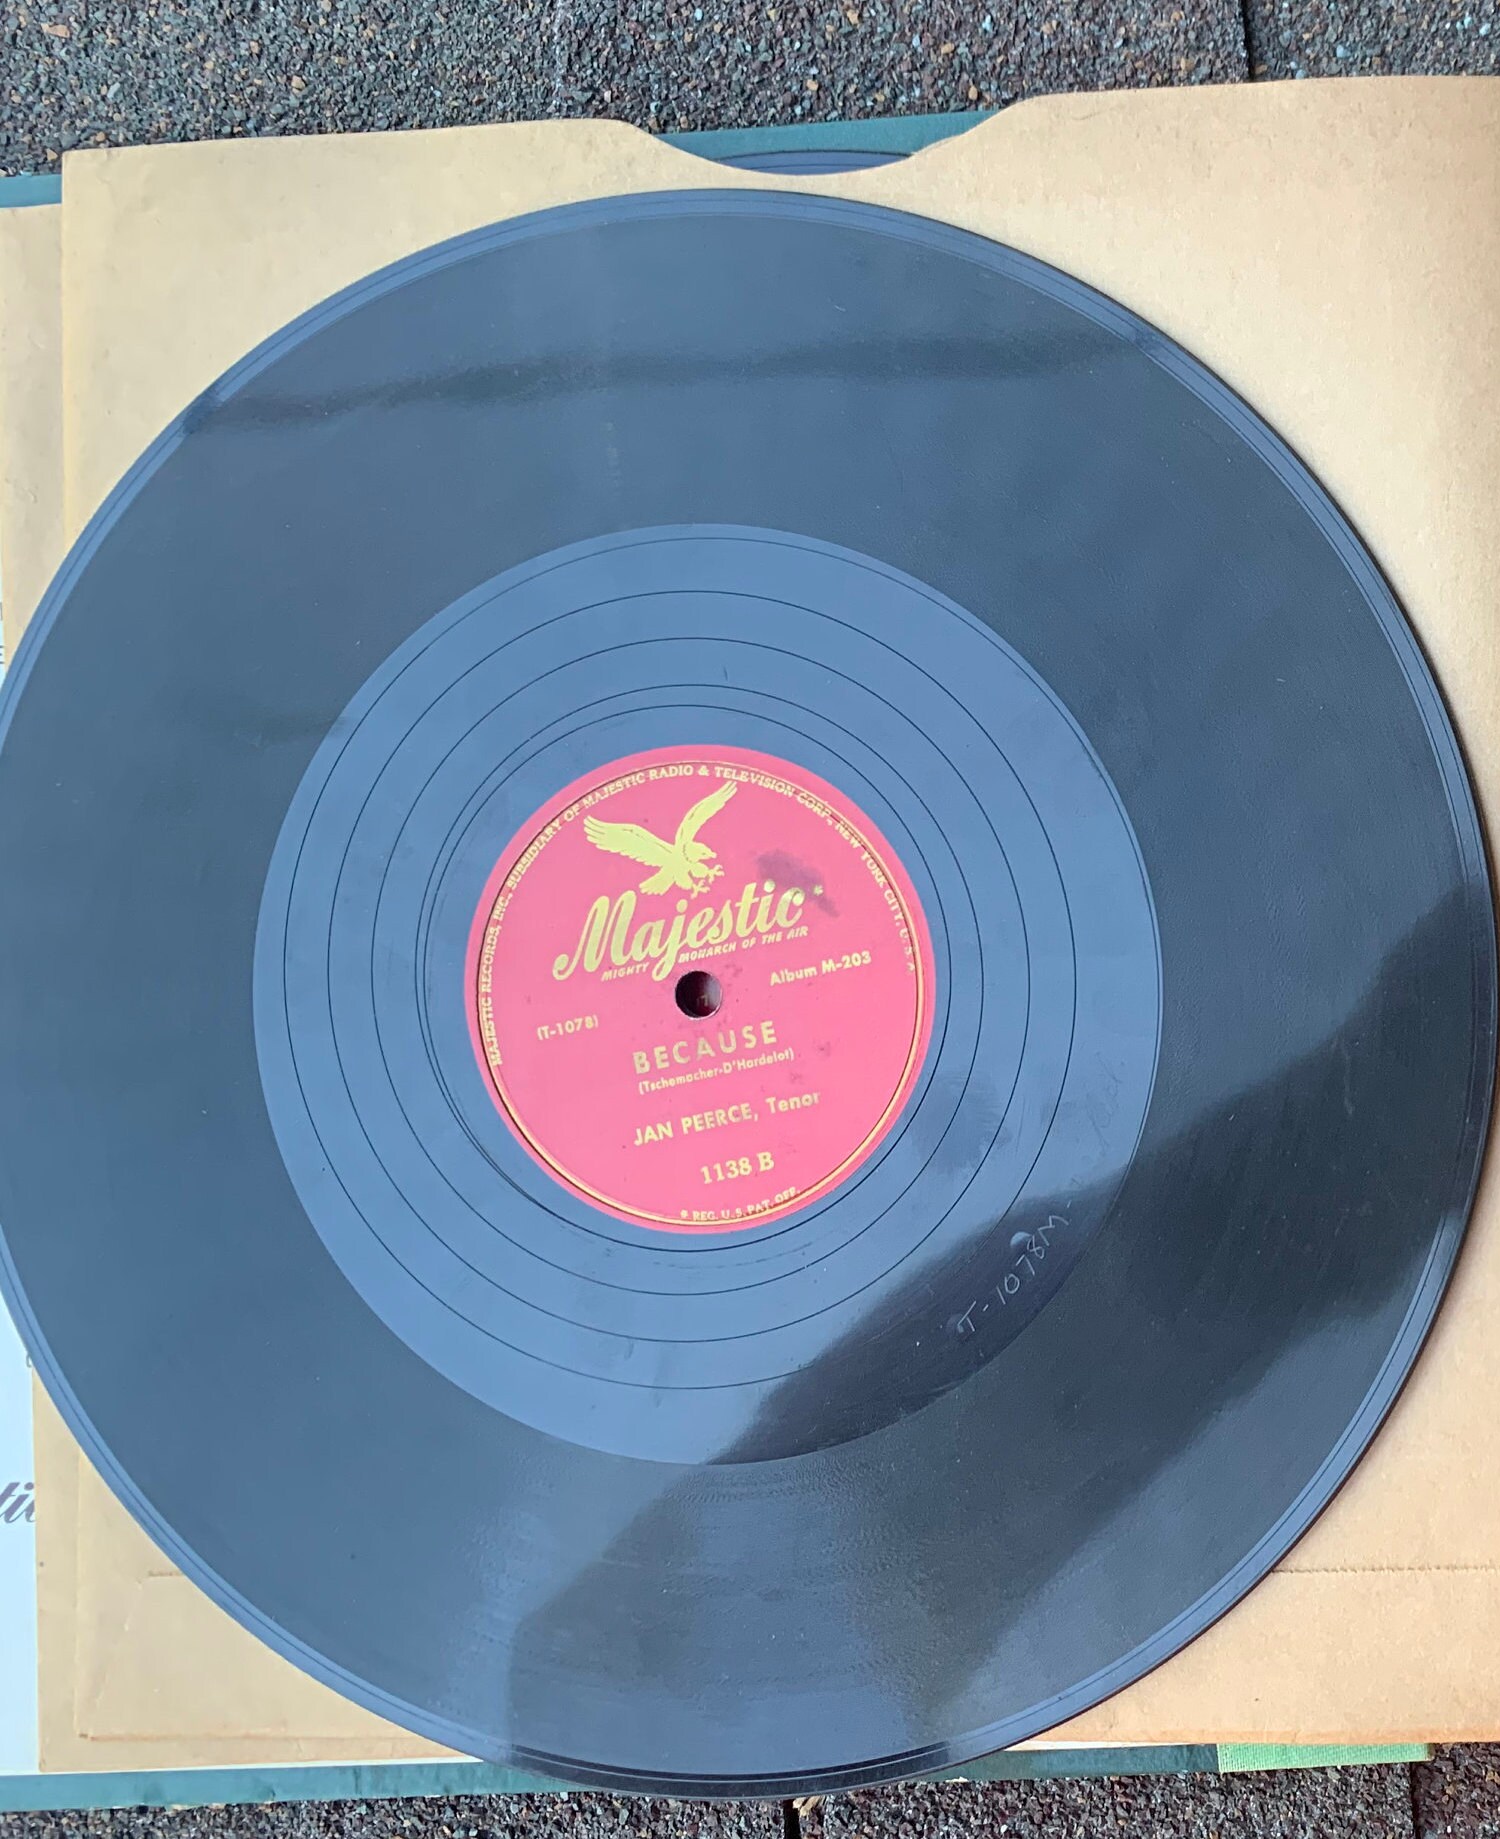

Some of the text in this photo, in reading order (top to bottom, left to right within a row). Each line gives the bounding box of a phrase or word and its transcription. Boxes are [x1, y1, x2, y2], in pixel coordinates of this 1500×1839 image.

[647, 763, 694, 781] RADIO
[697, 765, 709, 776] &
[714, 766, 796, 799] TELEVISION
[581, 771, 647, 810] MAJESTIC
[561, 803, 584, 823] OF
[833, 818, 864, 851] NEW
[504, 818, 564, 890] SUBSIDIARY
[858, 848, 889, 889] YORK
[552, 879, 805, 981] Majestic
[480, 922, 502, 993] RECORDS,
[601, 925, 809, 982] MIGHTY MONARCH OF THE AIR
[770, 950, 872, 987] Album M-203
[478, 996, 504, 1067] MAJESTIC
[536, 1014, 600, 1041] (T-1078)
[632, 1020, 777, 1075] BECAUSE
[633, 1091, 821, 1146] JAN PEERCE, Tenor
[700, 1151, 775, 1184] 1138 B
[691, 1210, 718, 1221] REG.
[745, 1197, 775, 1215] PAT.
